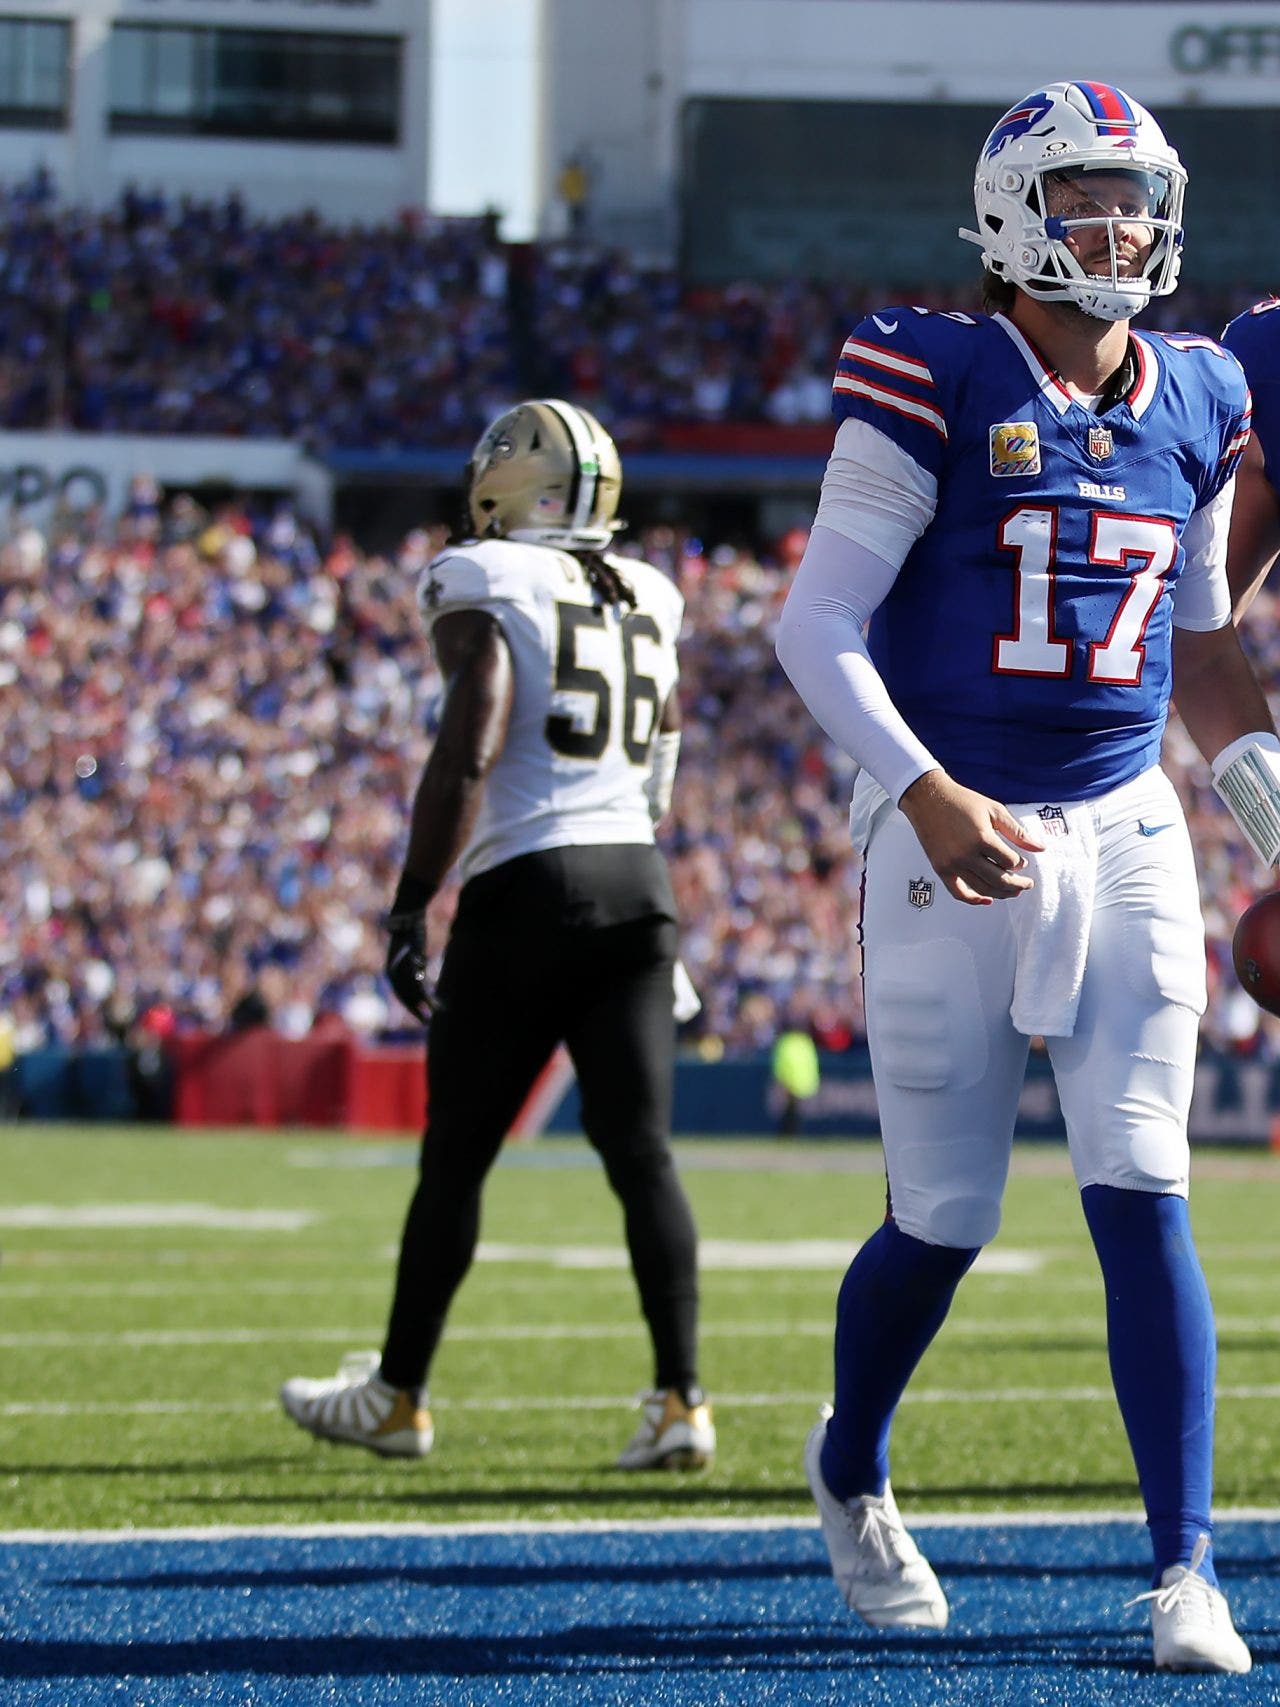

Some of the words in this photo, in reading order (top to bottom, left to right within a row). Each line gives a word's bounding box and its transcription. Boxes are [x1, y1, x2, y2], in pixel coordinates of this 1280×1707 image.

[993, 426, 1035, 462] C
[1091, 440, 1108, 455] NFL
[1078, 482, 1127, 501] BILLS
[991, 504, 1178, 686] 17
[546, 602, 661, 766] 56
[1043, 819, 1068, 837] NFL
[911, 891, 929, 906] NFL
